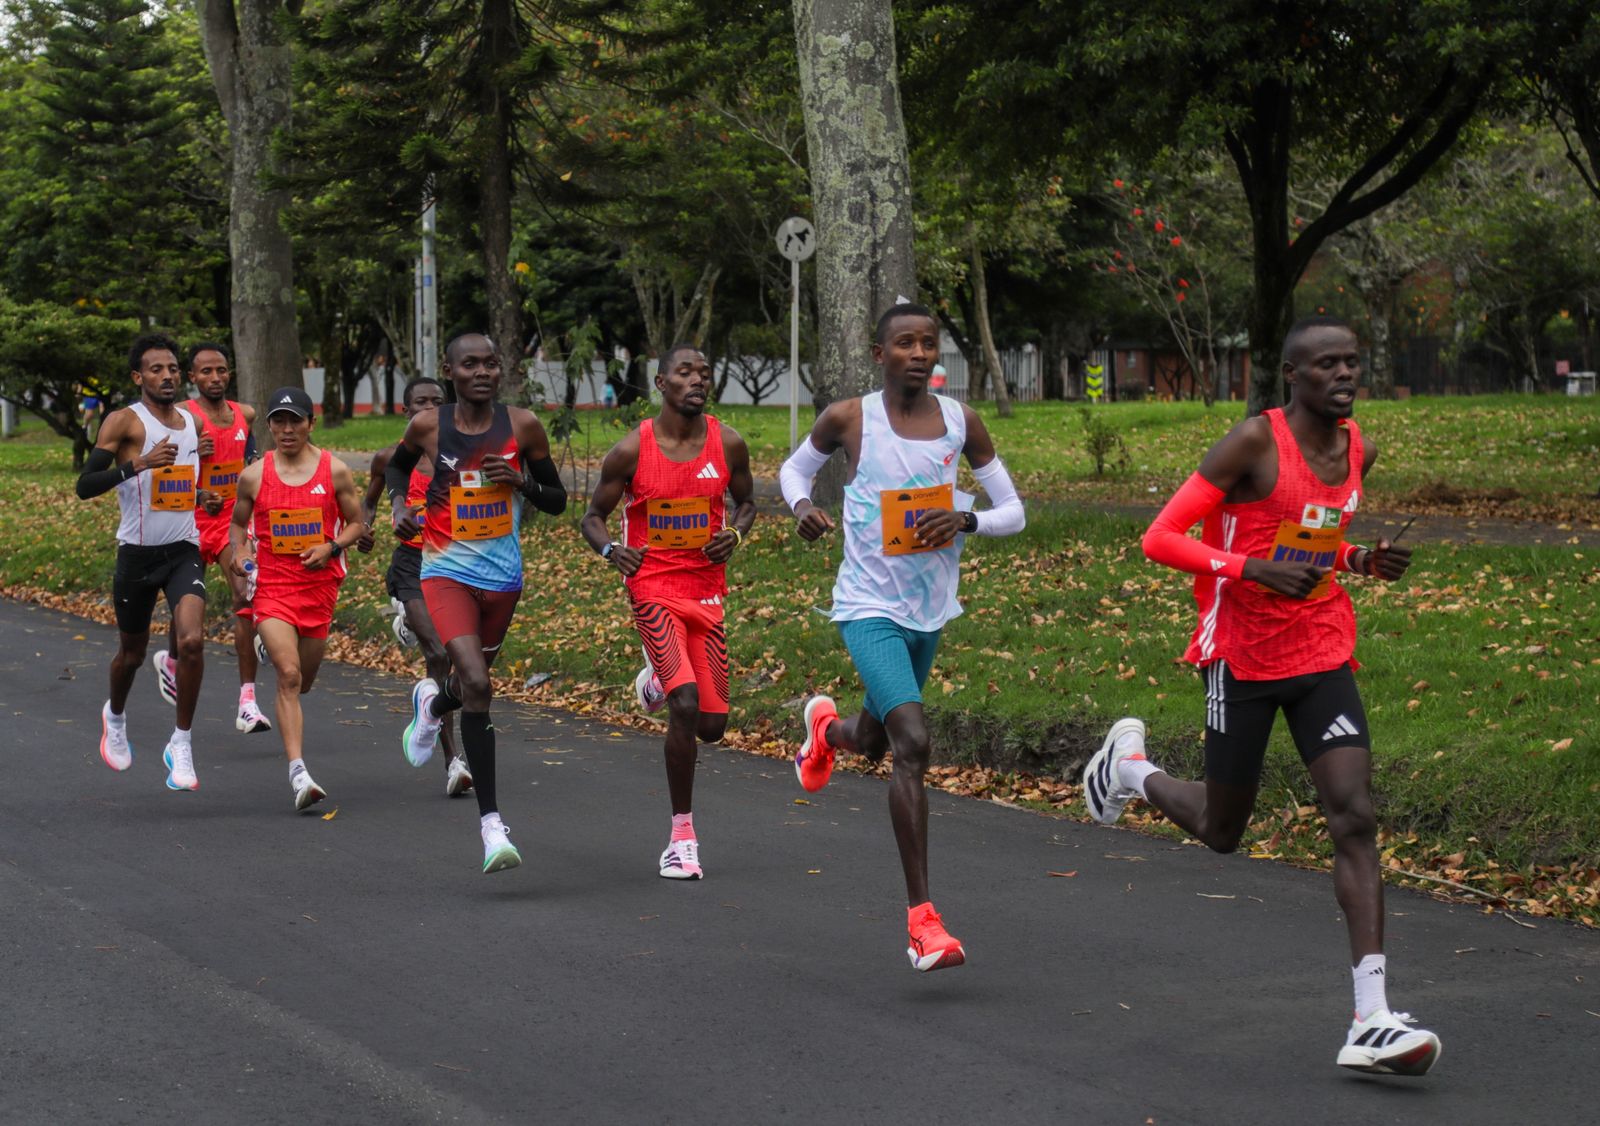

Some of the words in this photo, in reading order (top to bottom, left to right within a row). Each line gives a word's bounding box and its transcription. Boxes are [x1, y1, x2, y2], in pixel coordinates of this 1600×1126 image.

[158, 480, 192, 493] AMARE
[456, 500, 508, 520] MATATA
[272, 522, 322, 537] GARIBAY
[649, 513, 708, 530] KIPRUTO
